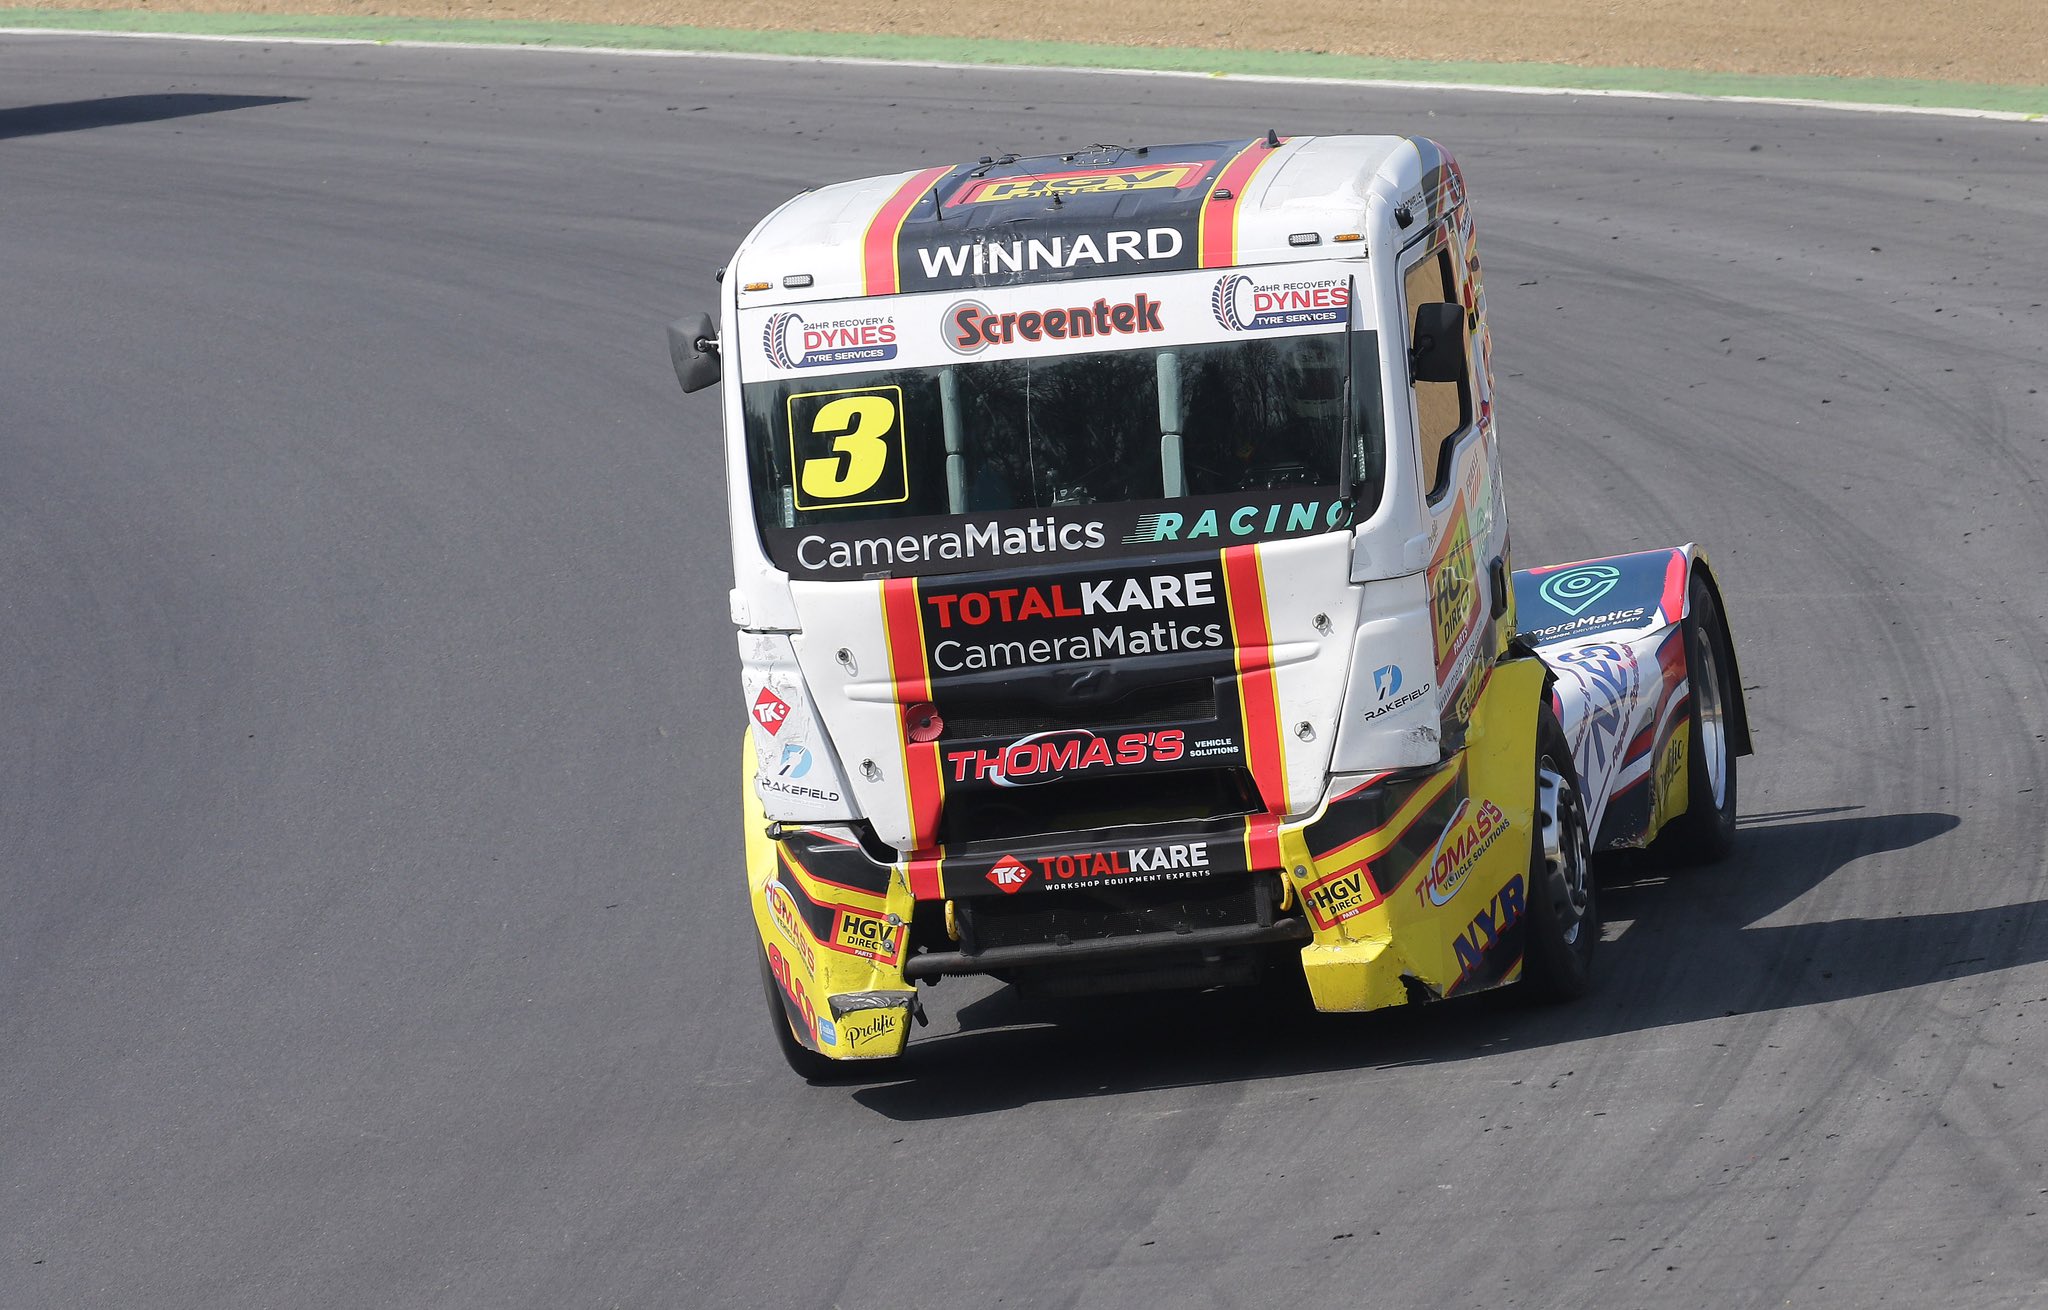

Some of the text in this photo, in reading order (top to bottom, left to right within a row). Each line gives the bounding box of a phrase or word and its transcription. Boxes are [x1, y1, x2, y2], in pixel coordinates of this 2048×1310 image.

[993, 169, 1174, 197] HGV
[917, 226, 1183, 279] WINNARD
[1253, 283, 1281, 293] 24HR
[1284, 279, 1337, 291] RECOVERY
[1253, 287, 1350, 312] DYNES
[803, 316, 894, 331] 24HR RECOVERY &
[953, 293, 1164, 349] Screentek
[1256, 312, 1337, 326] TYRE SERVICES
[803, 324, 897, 350] DYNES
[805, 349, 885, 363] TYRE SERVICES
[801, 395, 895, 499] 3
[797, 522, 1106, 571] CameraMatics
[927, 571, 1216, 629] TOTALKARE
[934, 620, 1224, 672] CameraMatics
[1364, 683, 1431, 721] RAKEFIELD
[948, 729, 1185, 782] THOMAS'S
[1190, 746, 1240, 758] SOLUTIONS
[1194, 738, 1232, 749] VEHICLE
[1472, 818, 1511, 862] SOLUTIONS
[1037, 842, 1210, 880] TOTALKARE
[1045, 869, 1211, 892] WORKSHOP EQUIPMENT EXPERTS
[1313, 873, 1361, 909] HGV
[1329, 893, 1363, 916] DIRECT
[1341, 908, 1360, 920] PARTS
[842, 915, 894, 941] HGV
[854, 949, 873, 959] PARTS
[845, 1014, 896, 1049] Prolific
